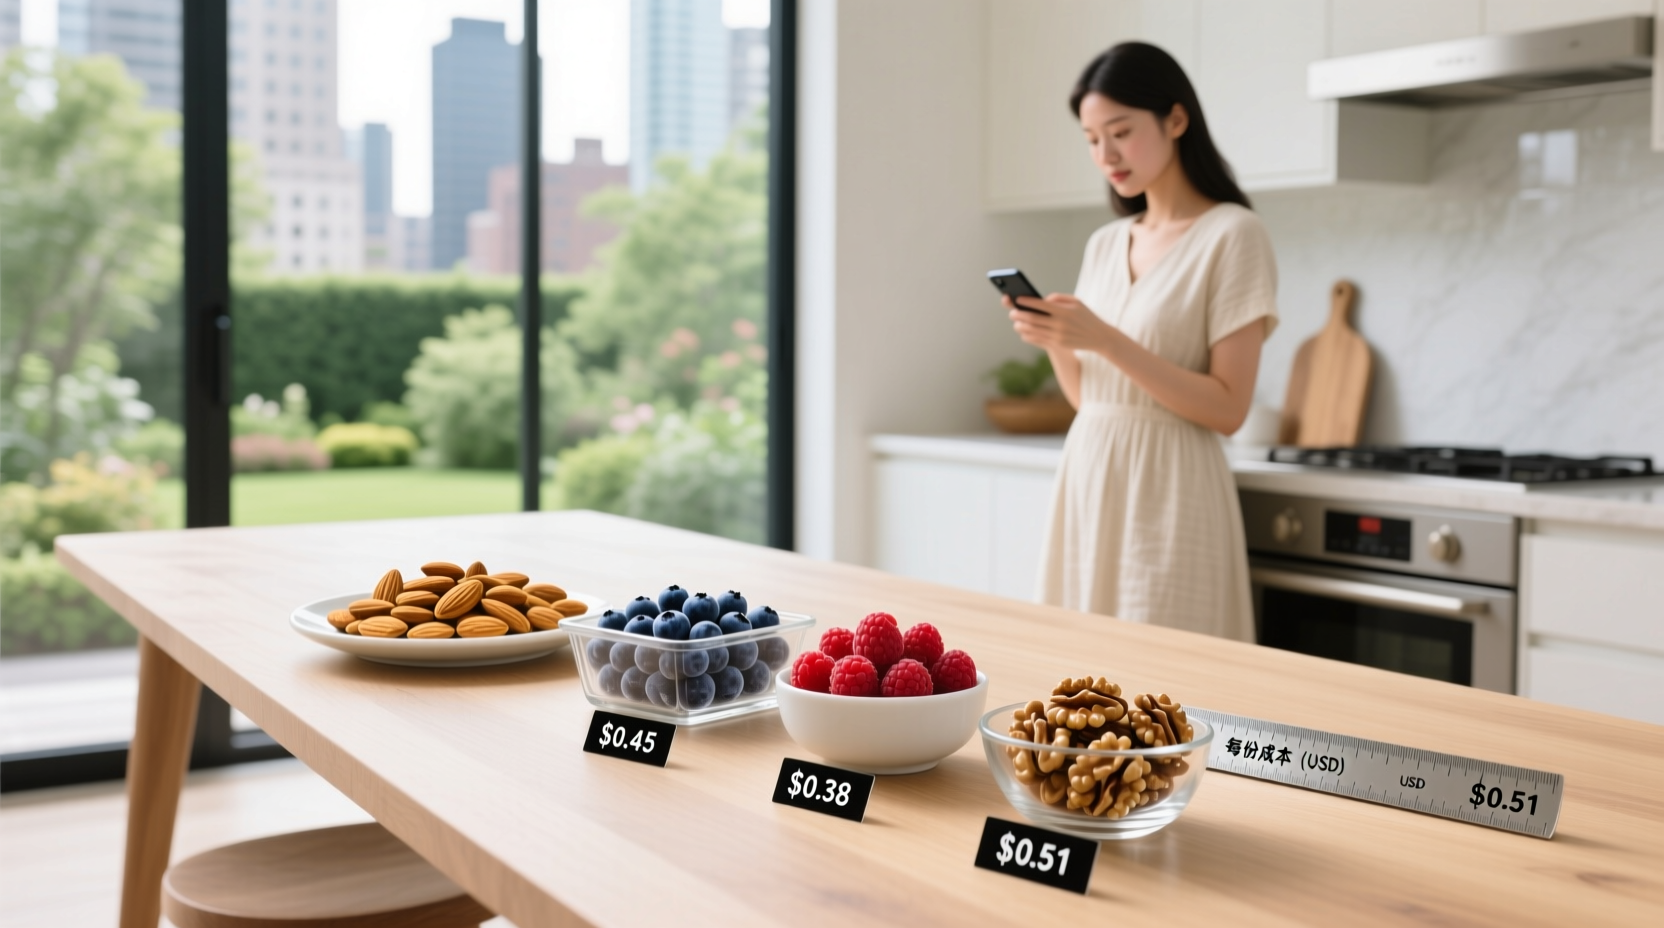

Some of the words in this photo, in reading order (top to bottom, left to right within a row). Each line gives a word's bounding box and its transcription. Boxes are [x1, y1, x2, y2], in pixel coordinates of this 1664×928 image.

[598, 721, 656, 753] $0.45
[1301, 751, 1345, 776] (USD)
[787, 769, 851, 806] $0.38
[1399, 775, 1426, 790] USD
[1469, 783, 1538, 815] $0.51
[996, 831, 1070, 876] $0.51
